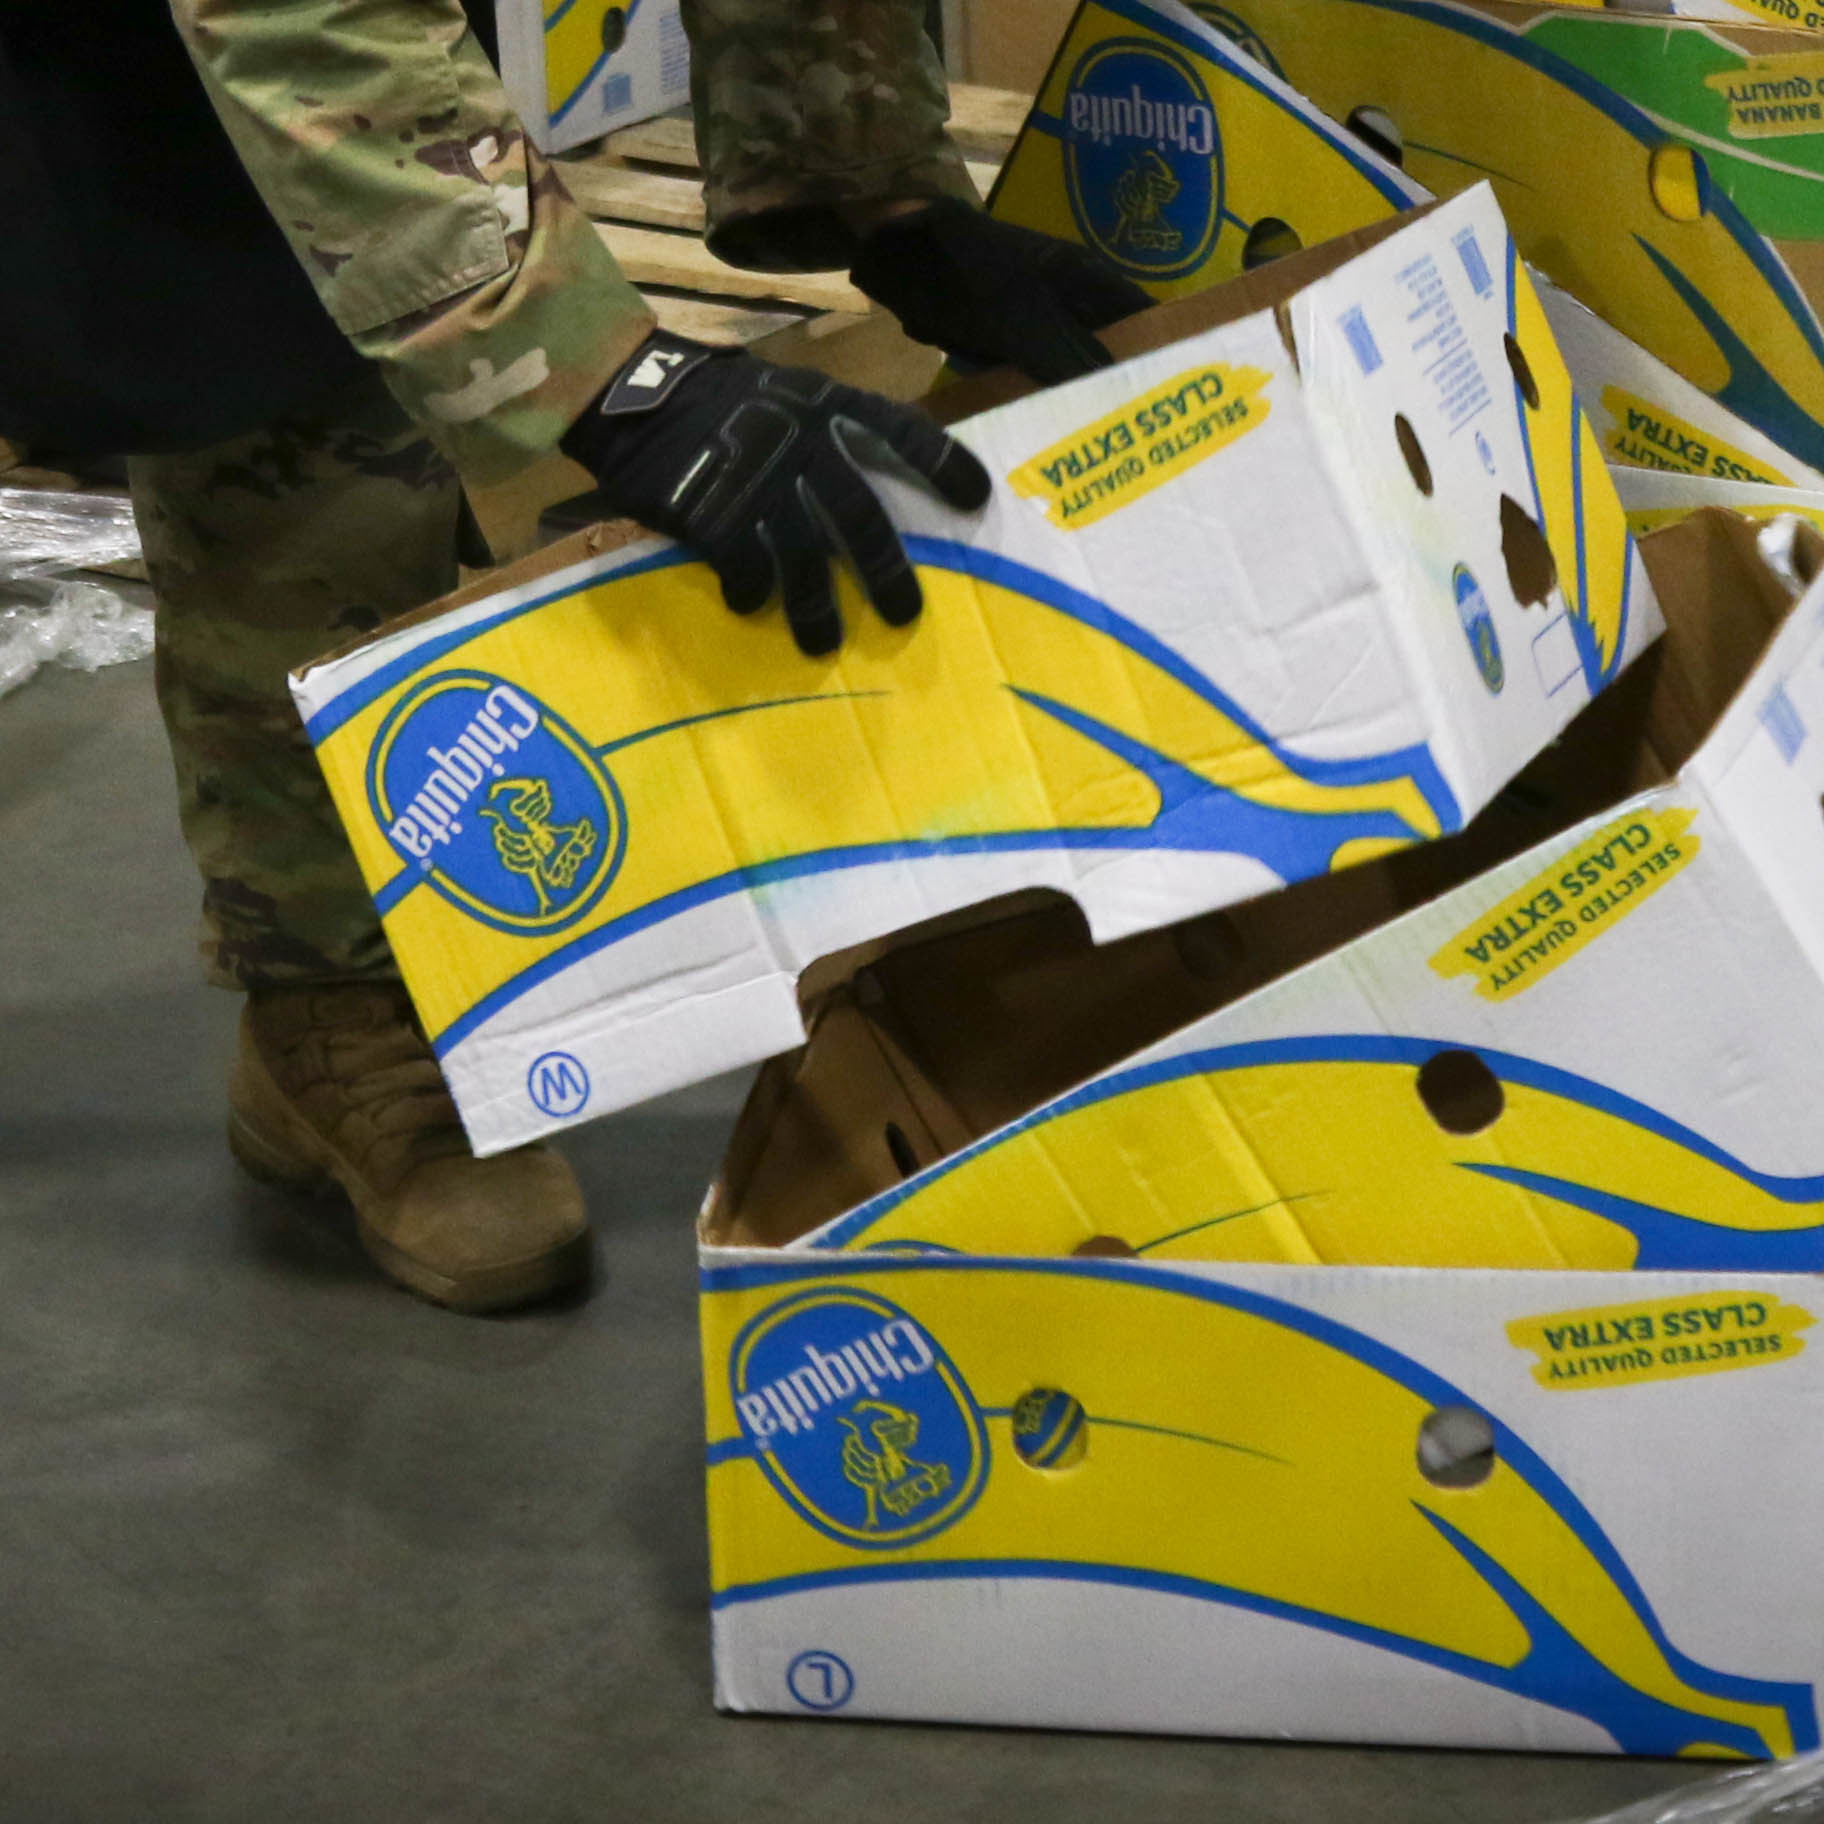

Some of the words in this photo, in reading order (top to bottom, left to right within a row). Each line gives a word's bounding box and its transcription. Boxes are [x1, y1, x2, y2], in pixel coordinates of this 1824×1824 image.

[1070, 84, 1214, 156] Chiquita
[1728, 76, 1812, 102] QUALITY
[1735, 99, 1820, 125] BANANA
[1135, 371, 1225, 437] CLASS
[1147, 395, 1250, 468] SELECTED
[1042, 430, 1136, 488] EXTRA
[1626, 407, 1709, 467] EXTRA
[1059, 461, 1146, 519] QUALITY
[387, 684, 539, 857] Chiquita
[1560, 823, 1651, 898] CLASS
[1579, 844, 1682, 924] SELECTED
[1464, 892, 1564, 965] EXTRA
[1490, 920, 1578, 991] QUALITY
[1544, 1315, 1654, 1352] EXTRA
[1662, 1301, 1767, 1338] CLASS
[1663, 1335, 1782, 1366] SELECTED
[736, 1319, 935, 1437] Chiquita
[1549, 1350, 1654, 1380] QUALITY
